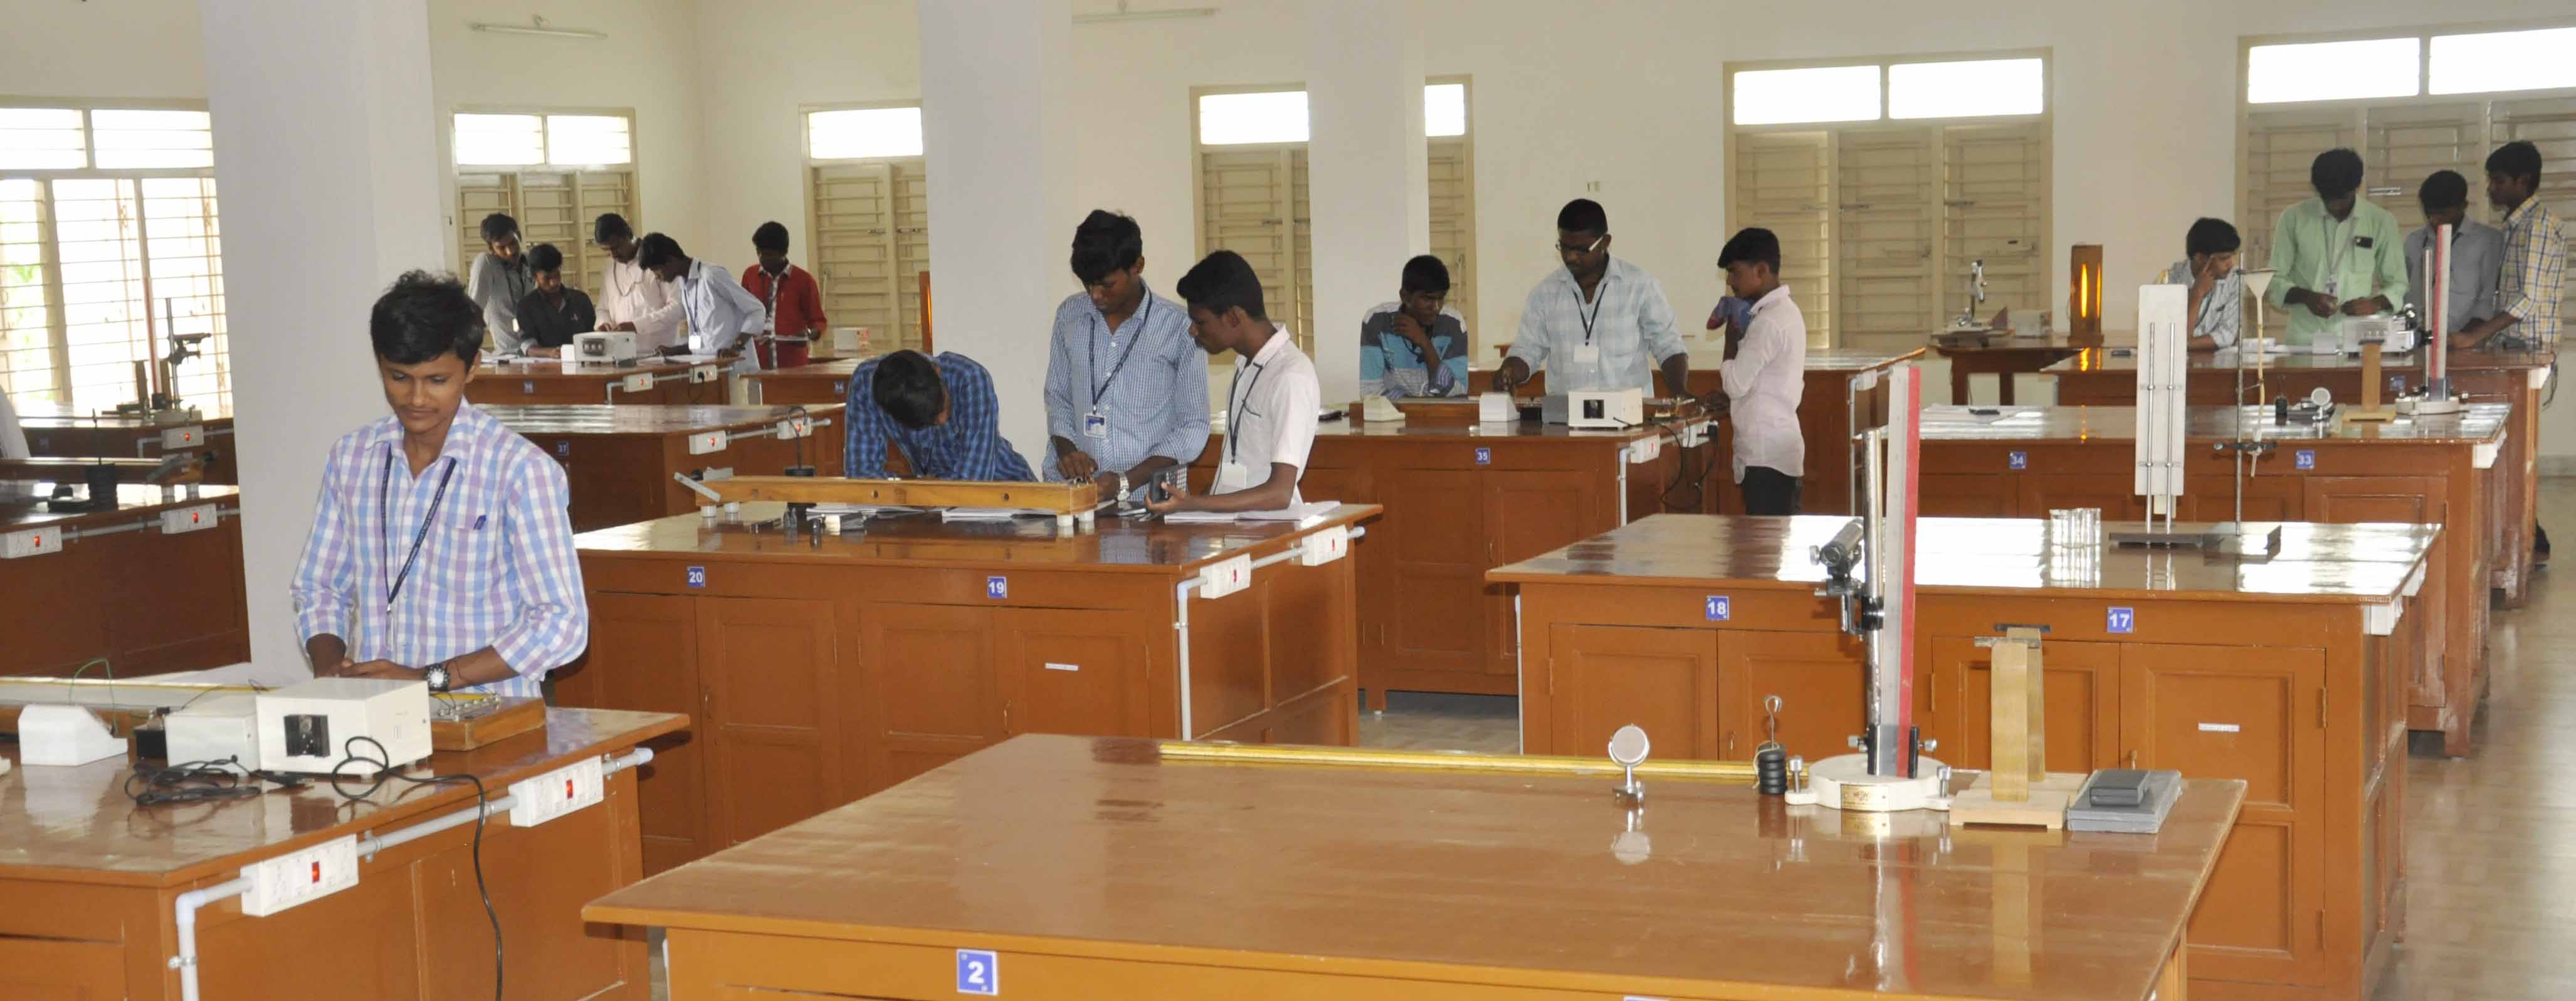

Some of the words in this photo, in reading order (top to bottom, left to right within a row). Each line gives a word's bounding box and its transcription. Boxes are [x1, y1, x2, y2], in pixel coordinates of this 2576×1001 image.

[1477, 452, 1488, 461] 35
[2011, 456, 2024, 465] 34
[2298, 455, 2312, 465] 33
[689, 571, 702, 583] 20
[989, 581, 1004, 593] 19
[1708, 601, 1726, 615] 18
[2110, 613, 2130, 628] 17
[968, 961, 984, 984] 2
